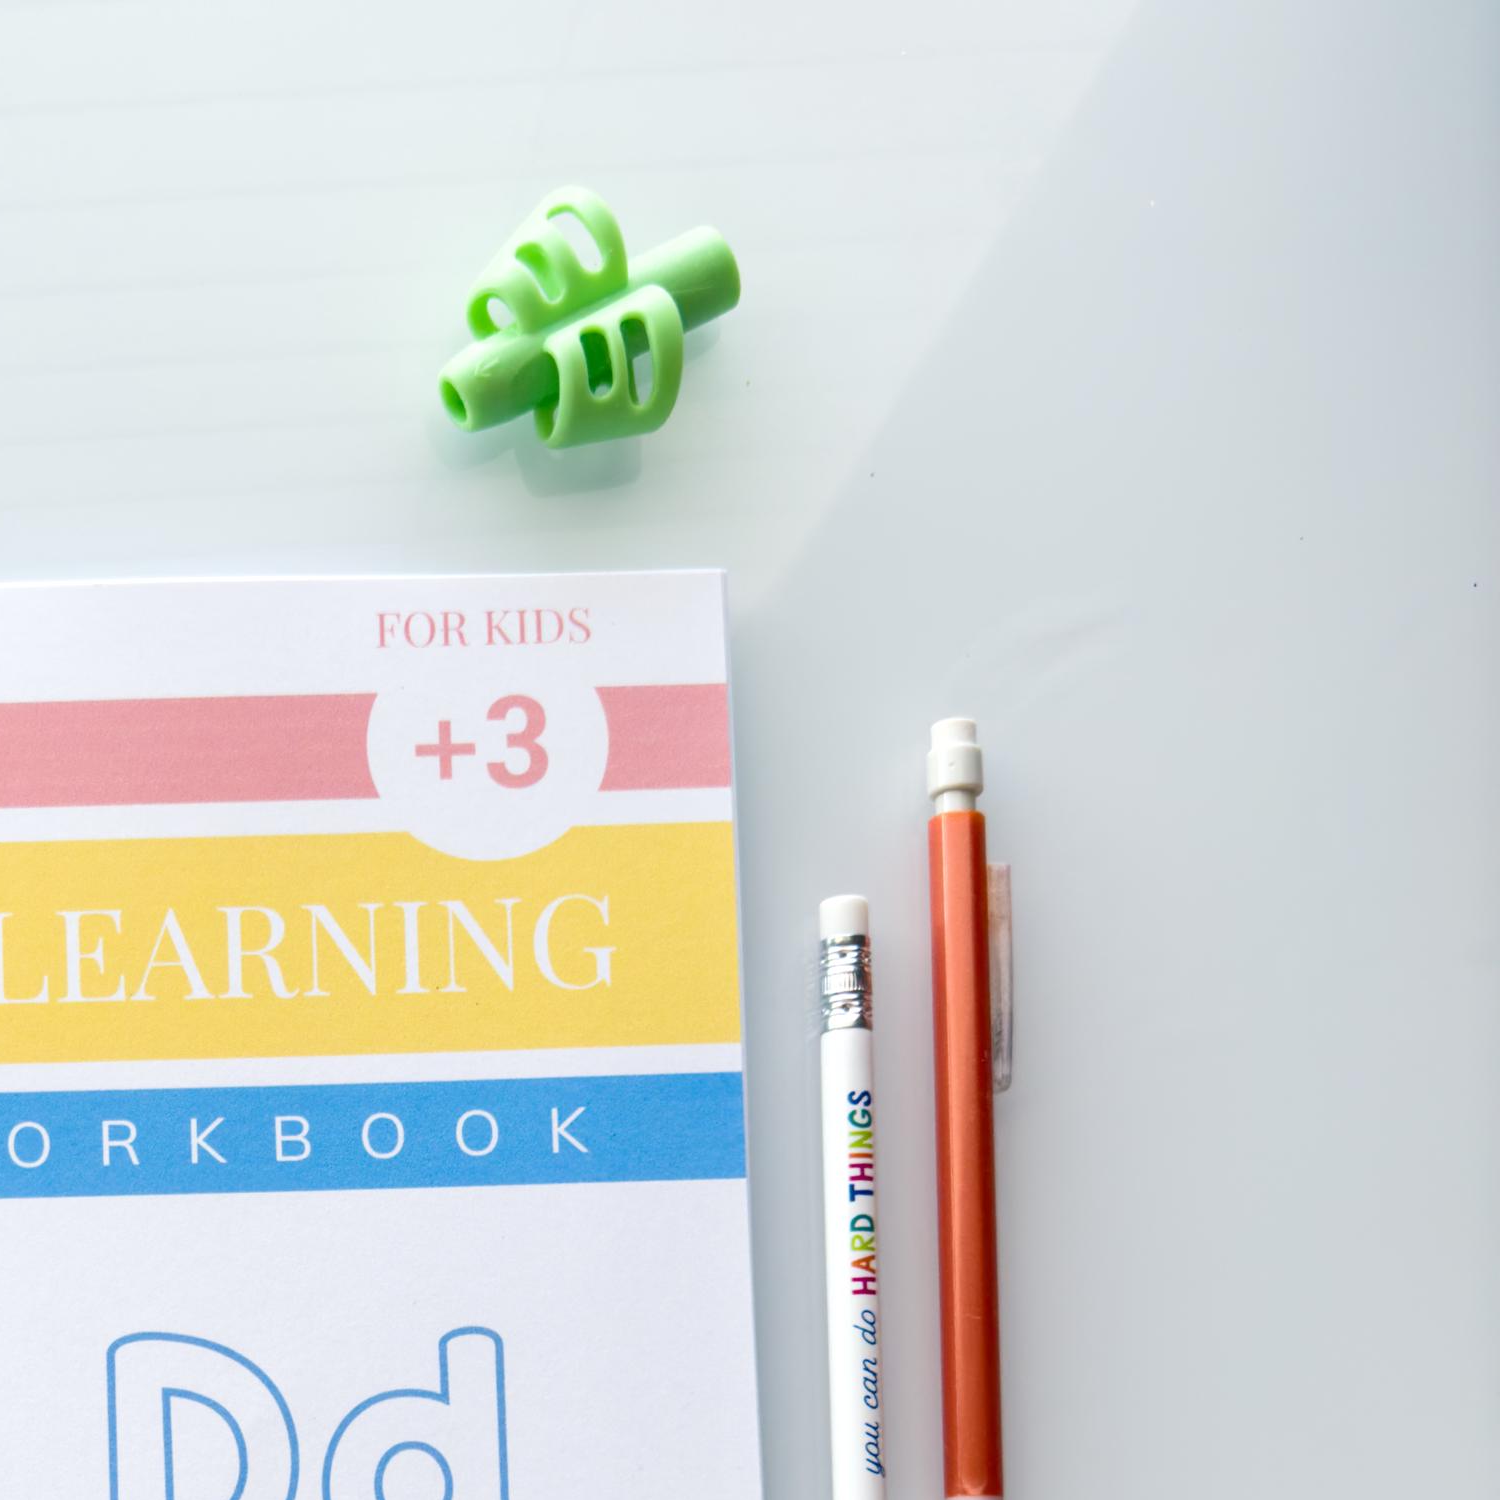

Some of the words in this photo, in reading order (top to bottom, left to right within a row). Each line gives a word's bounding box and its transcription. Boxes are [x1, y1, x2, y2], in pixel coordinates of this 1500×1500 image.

[376, 611, 468, 649] FOR
[485, 608, 592, 646] KIDS
[414, 694, 550, 789] +3
[847, 1089, 875, 1203] THINGS
[850, 1213, 877, 1296] HARD
[853, 1309, 877, 1345] do
[860, 1357, 879, 1410] can
[866, 1421, 885, 1478] you
